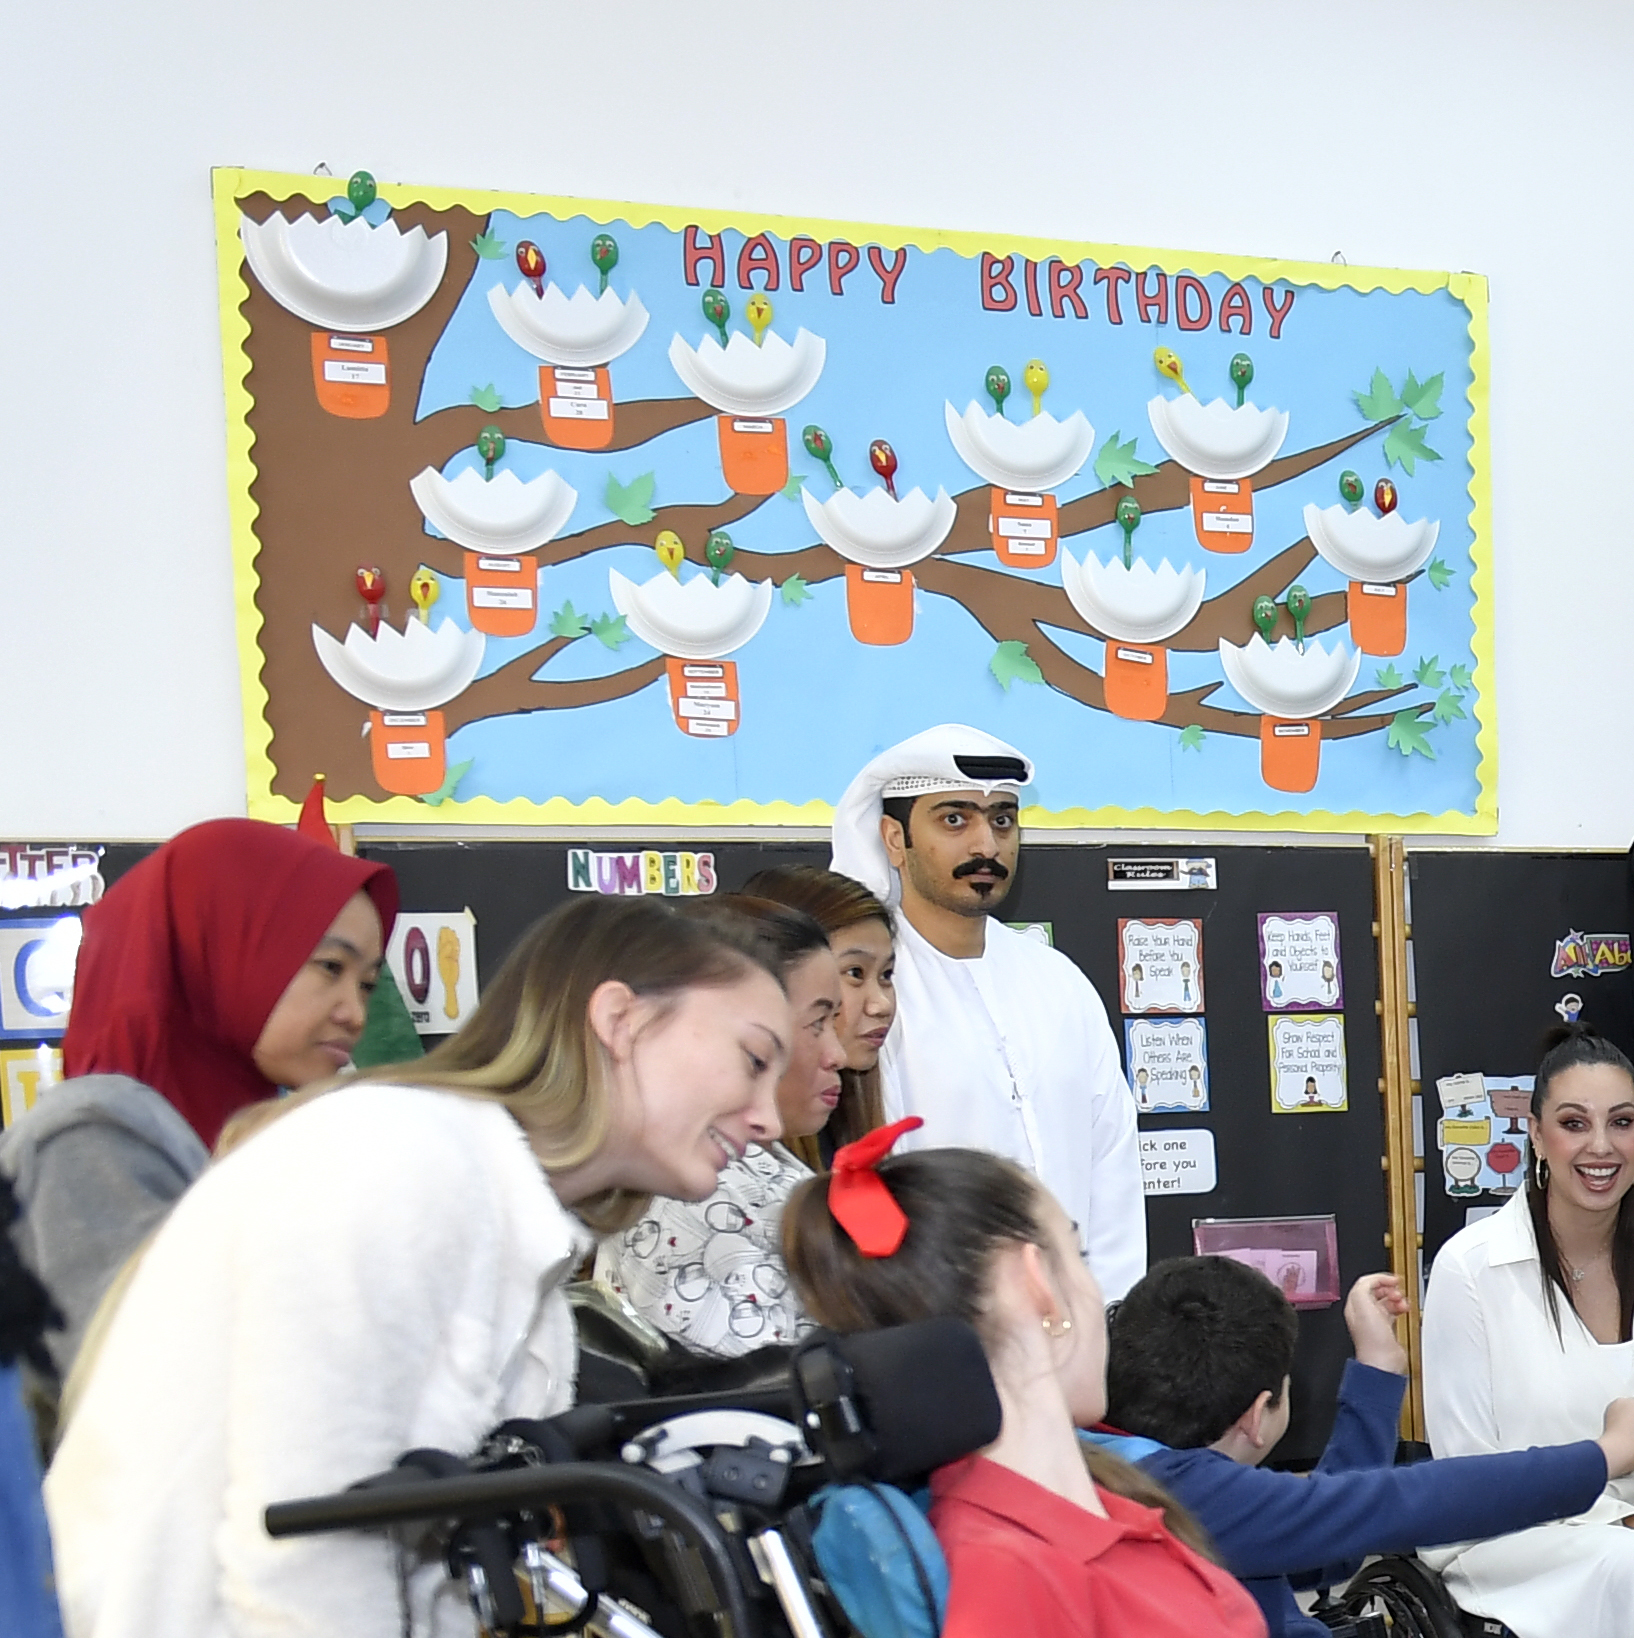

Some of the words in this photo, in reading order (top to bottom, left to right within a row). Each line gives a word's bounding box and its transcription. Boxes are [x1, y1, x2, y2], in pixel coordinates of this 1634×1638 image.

[683, 224, 907, 304] HAPPY
[981, 251, 1296, 339] BIRTHDAY
[0, 844, 97, 881] TTE
[1113, 863, 1173, 871] Classroom
[571, 851, 715, 895] NUMBERS
[1128, 934, 1149, 947] Raise
[1151, 934, 1170, 947] Your
[1173, 934, 1193, 947] Hand
[1267, 931, 1285, 946] Keep
[1315, 929, 1331, 942] Feet
[1139, 949, 1166, 962] Before
[1169, 949, 1184, 962] You
[1272, 946, 1287, 957] and
[1289, 945, 1318, 961] Objects
[1321, 945, 1329, 956] to
[1594, 941, 1633, 966] Ab
[404, 926, 431, 1005] 0
[1288, 959, 1319, 971] Yourself
[1149, 965, 1173, 981] Speak
[1140, 1033, 1166, 1047] Listen
[1168, 1033, 1193, 1046] When
[1282, 1031, 1303, 1044] Show
[1306, 1031, 1335, 1046] Respect
[1143, 1051, 1172, 1064] Others
[1175, 1050, 1193, 1063] Are
[1281, 1047, 1294, 1059] For
[1297, 1047, 1321, 1059] School
[1324, 1046, 1337, 1058] and
[1278, 1061, 1308, 1074] Personal
[1311, 1061, 1340, 1076] Property
[1150, 1067, 1187, 1086] Speaking
[1139, 1140, 1158, 1152] ick
[1163, 1141, 1187, 1152] one
[1141, 1158, 1168, 1171] fore
[1172, 1160, 1197, 1173] you
